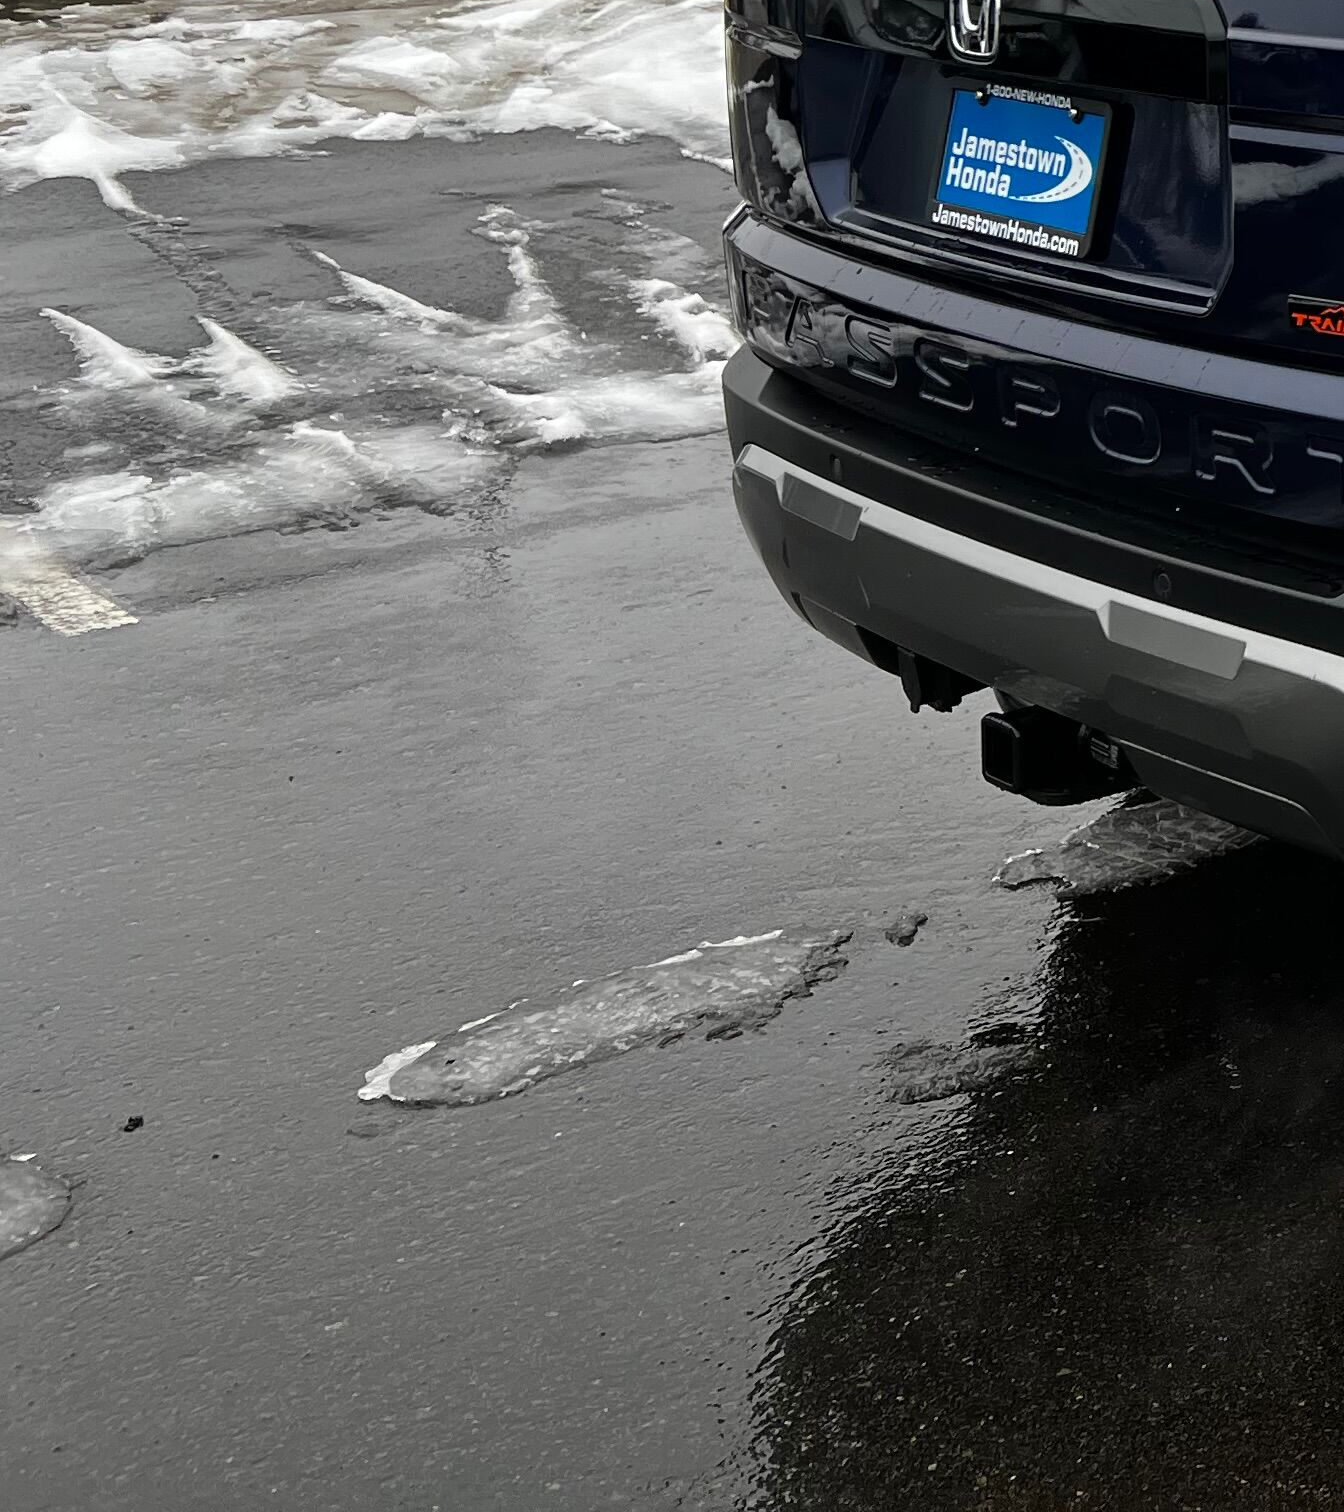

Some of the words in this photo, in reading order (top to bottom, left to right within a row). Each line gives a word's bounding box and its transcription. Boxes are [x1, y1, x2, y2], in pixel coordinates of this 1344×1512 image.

[986, 84, 1072, 109] 1-800-NEW-HONDA
[952, 127, 1066, 177] Jamestown
[945, 156, 1012, 198] Honda
[932, 204, 1079, 256] JamestownHonda.com
